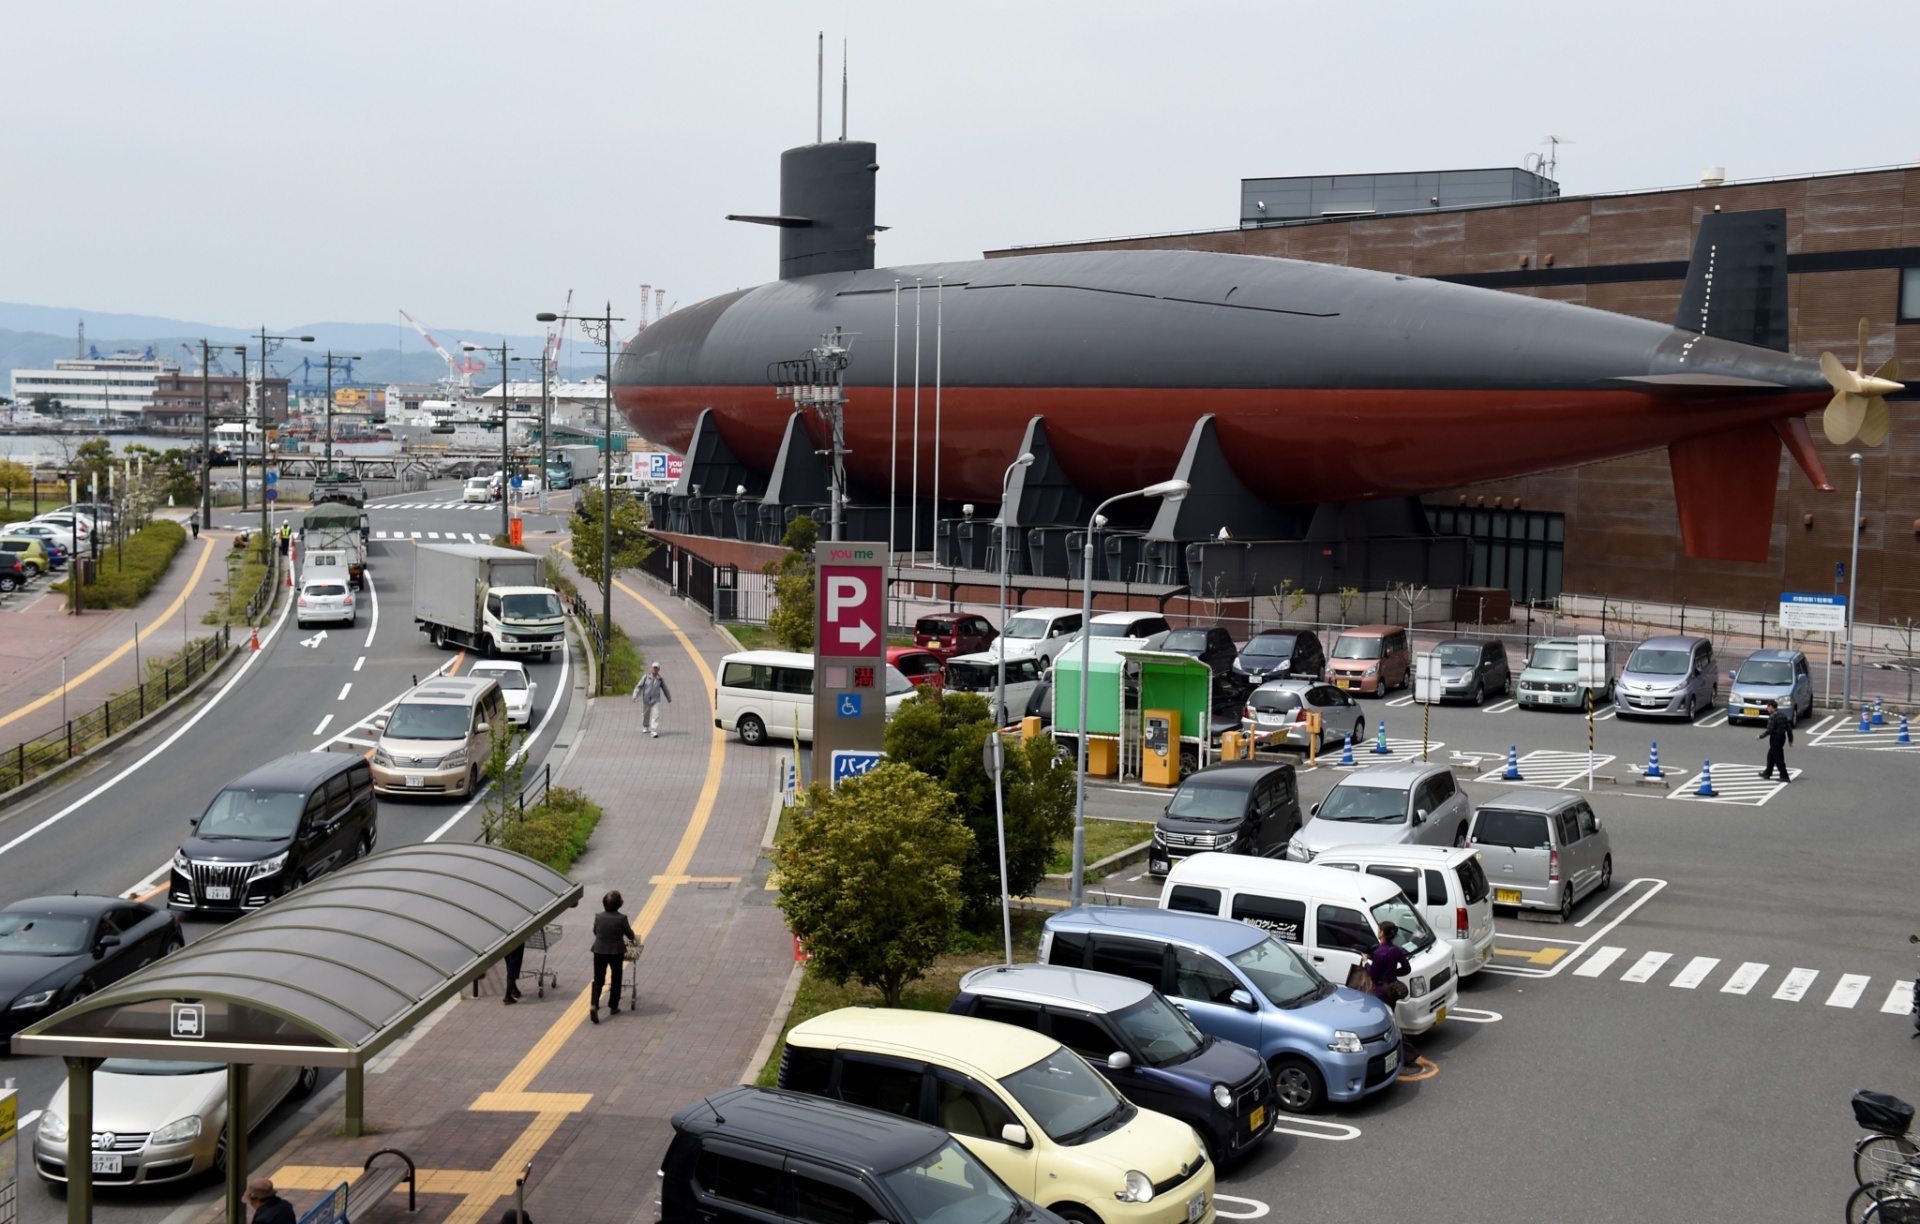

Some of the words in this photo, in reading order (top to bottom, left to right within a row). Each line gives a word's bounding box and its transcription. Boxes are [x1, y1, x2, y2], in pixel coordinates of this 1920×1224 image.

[652, 456, 663, 472] P
[668, 460, 682, 469] you
[830, 550, 852, 561] you
[854, 550, 874, 558] me
[827, 576, 867, 622] P
[840, 758, 879, 774] バイ
[93, 1162, 118, 1172] 37-41
